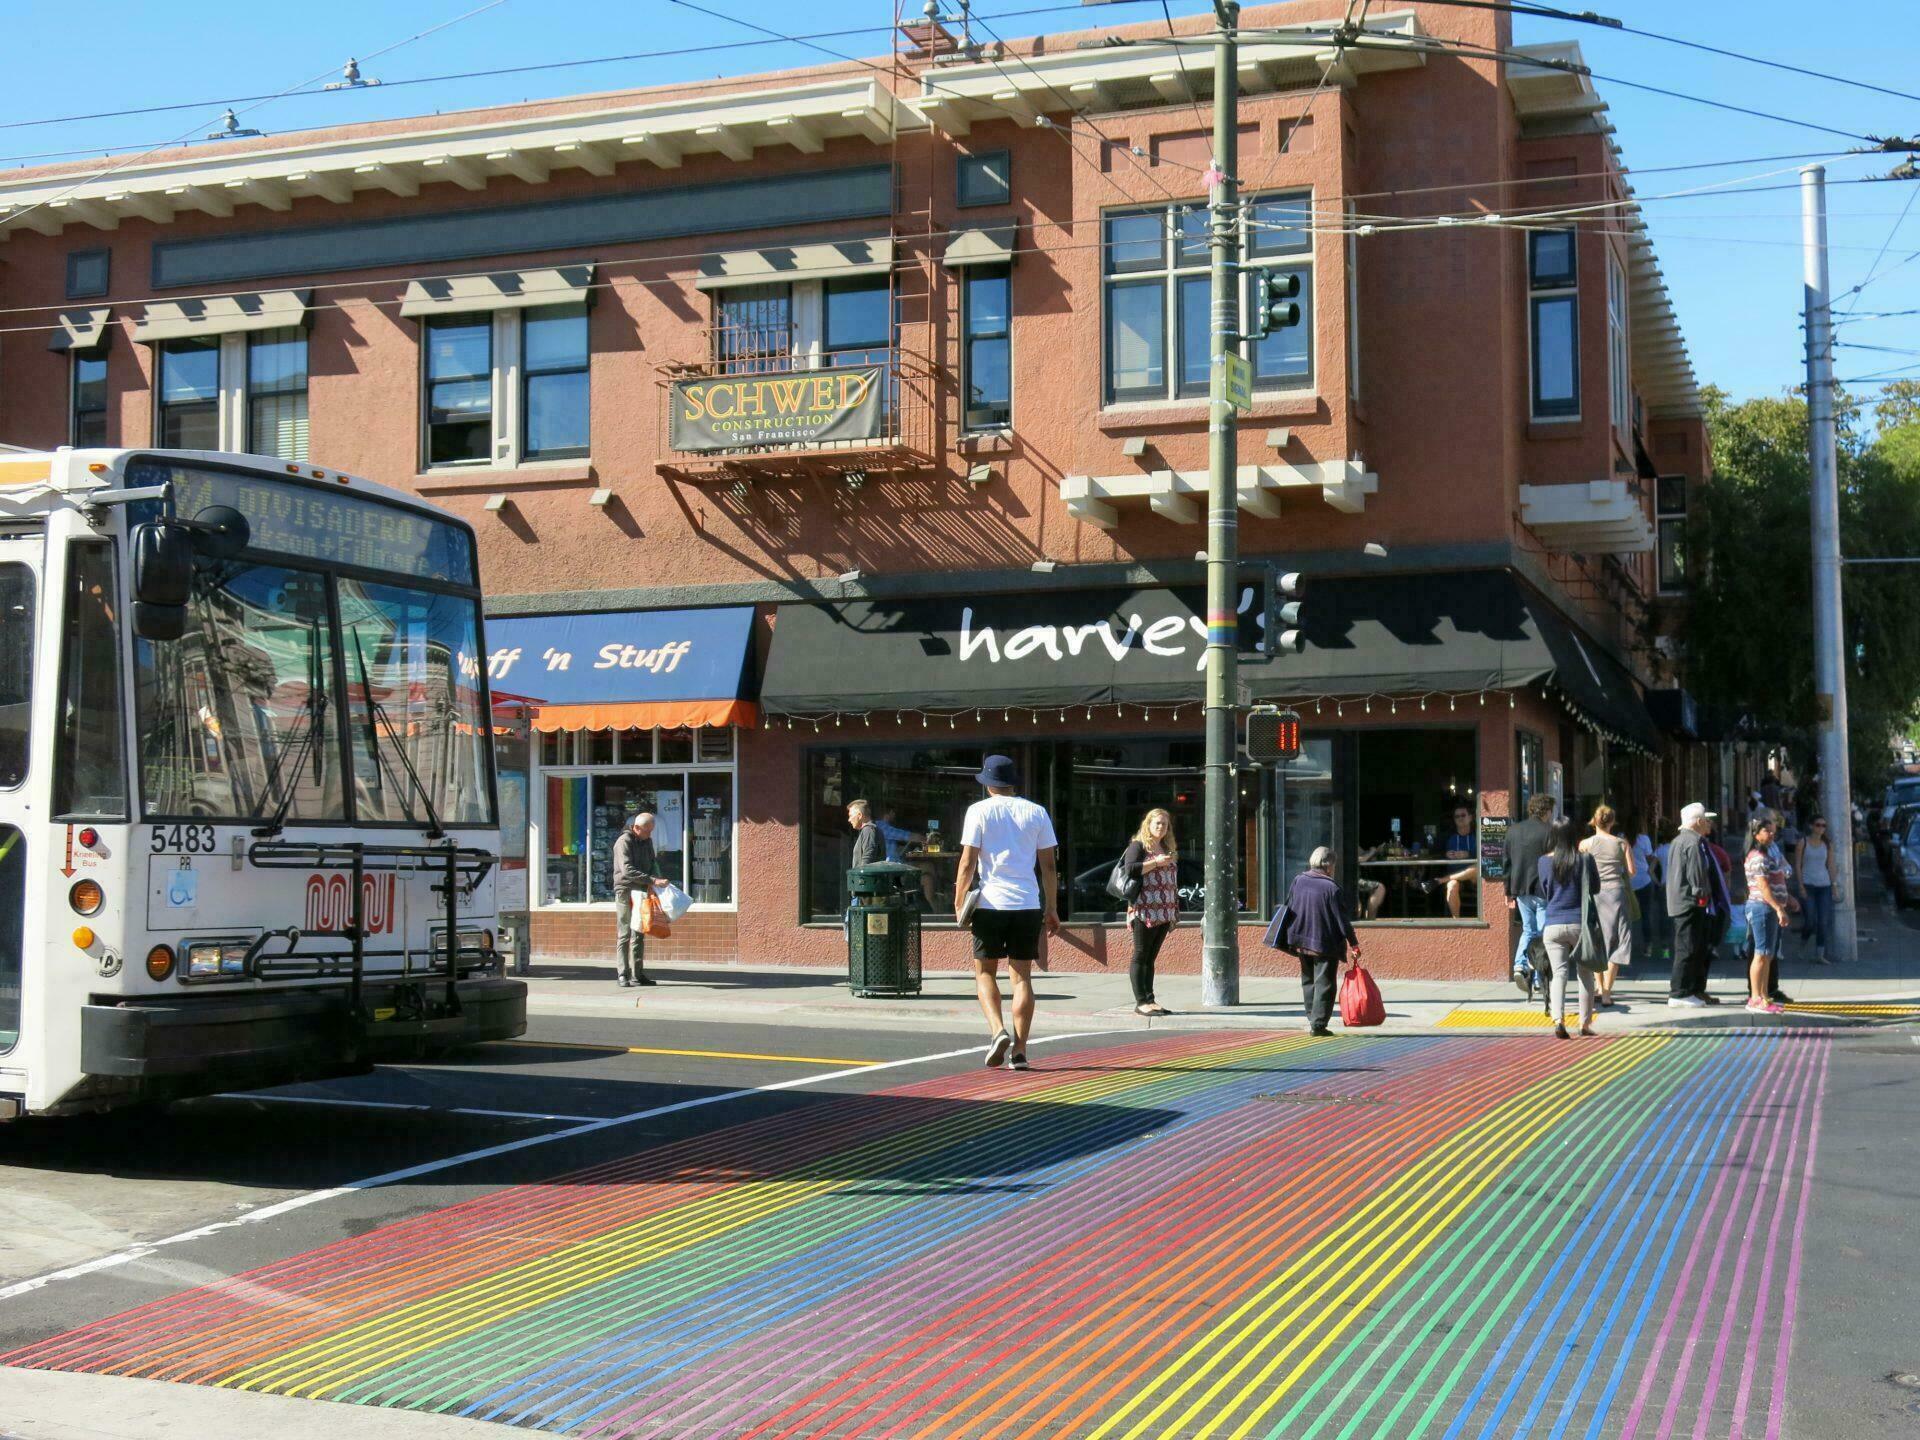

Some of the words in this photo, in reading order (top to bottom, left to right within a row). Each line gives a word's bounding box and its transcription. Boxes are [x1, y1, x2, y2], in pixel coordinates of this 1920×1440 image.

[685, 374, 868, 420] SCHWED
[711, 414, 834, 433] CONSTRUCTION
[732, 432, 752, 442] San
[758, 429, 816, 440] Francisco
[238, 487, 413, 545] DIVISADERO
[593, 640, 692, 674] Stuff
[151, 825, 216, 852] 5483
[73, 851, 107, 860] Kneeling
[82, 859, 97, 867] Bus
